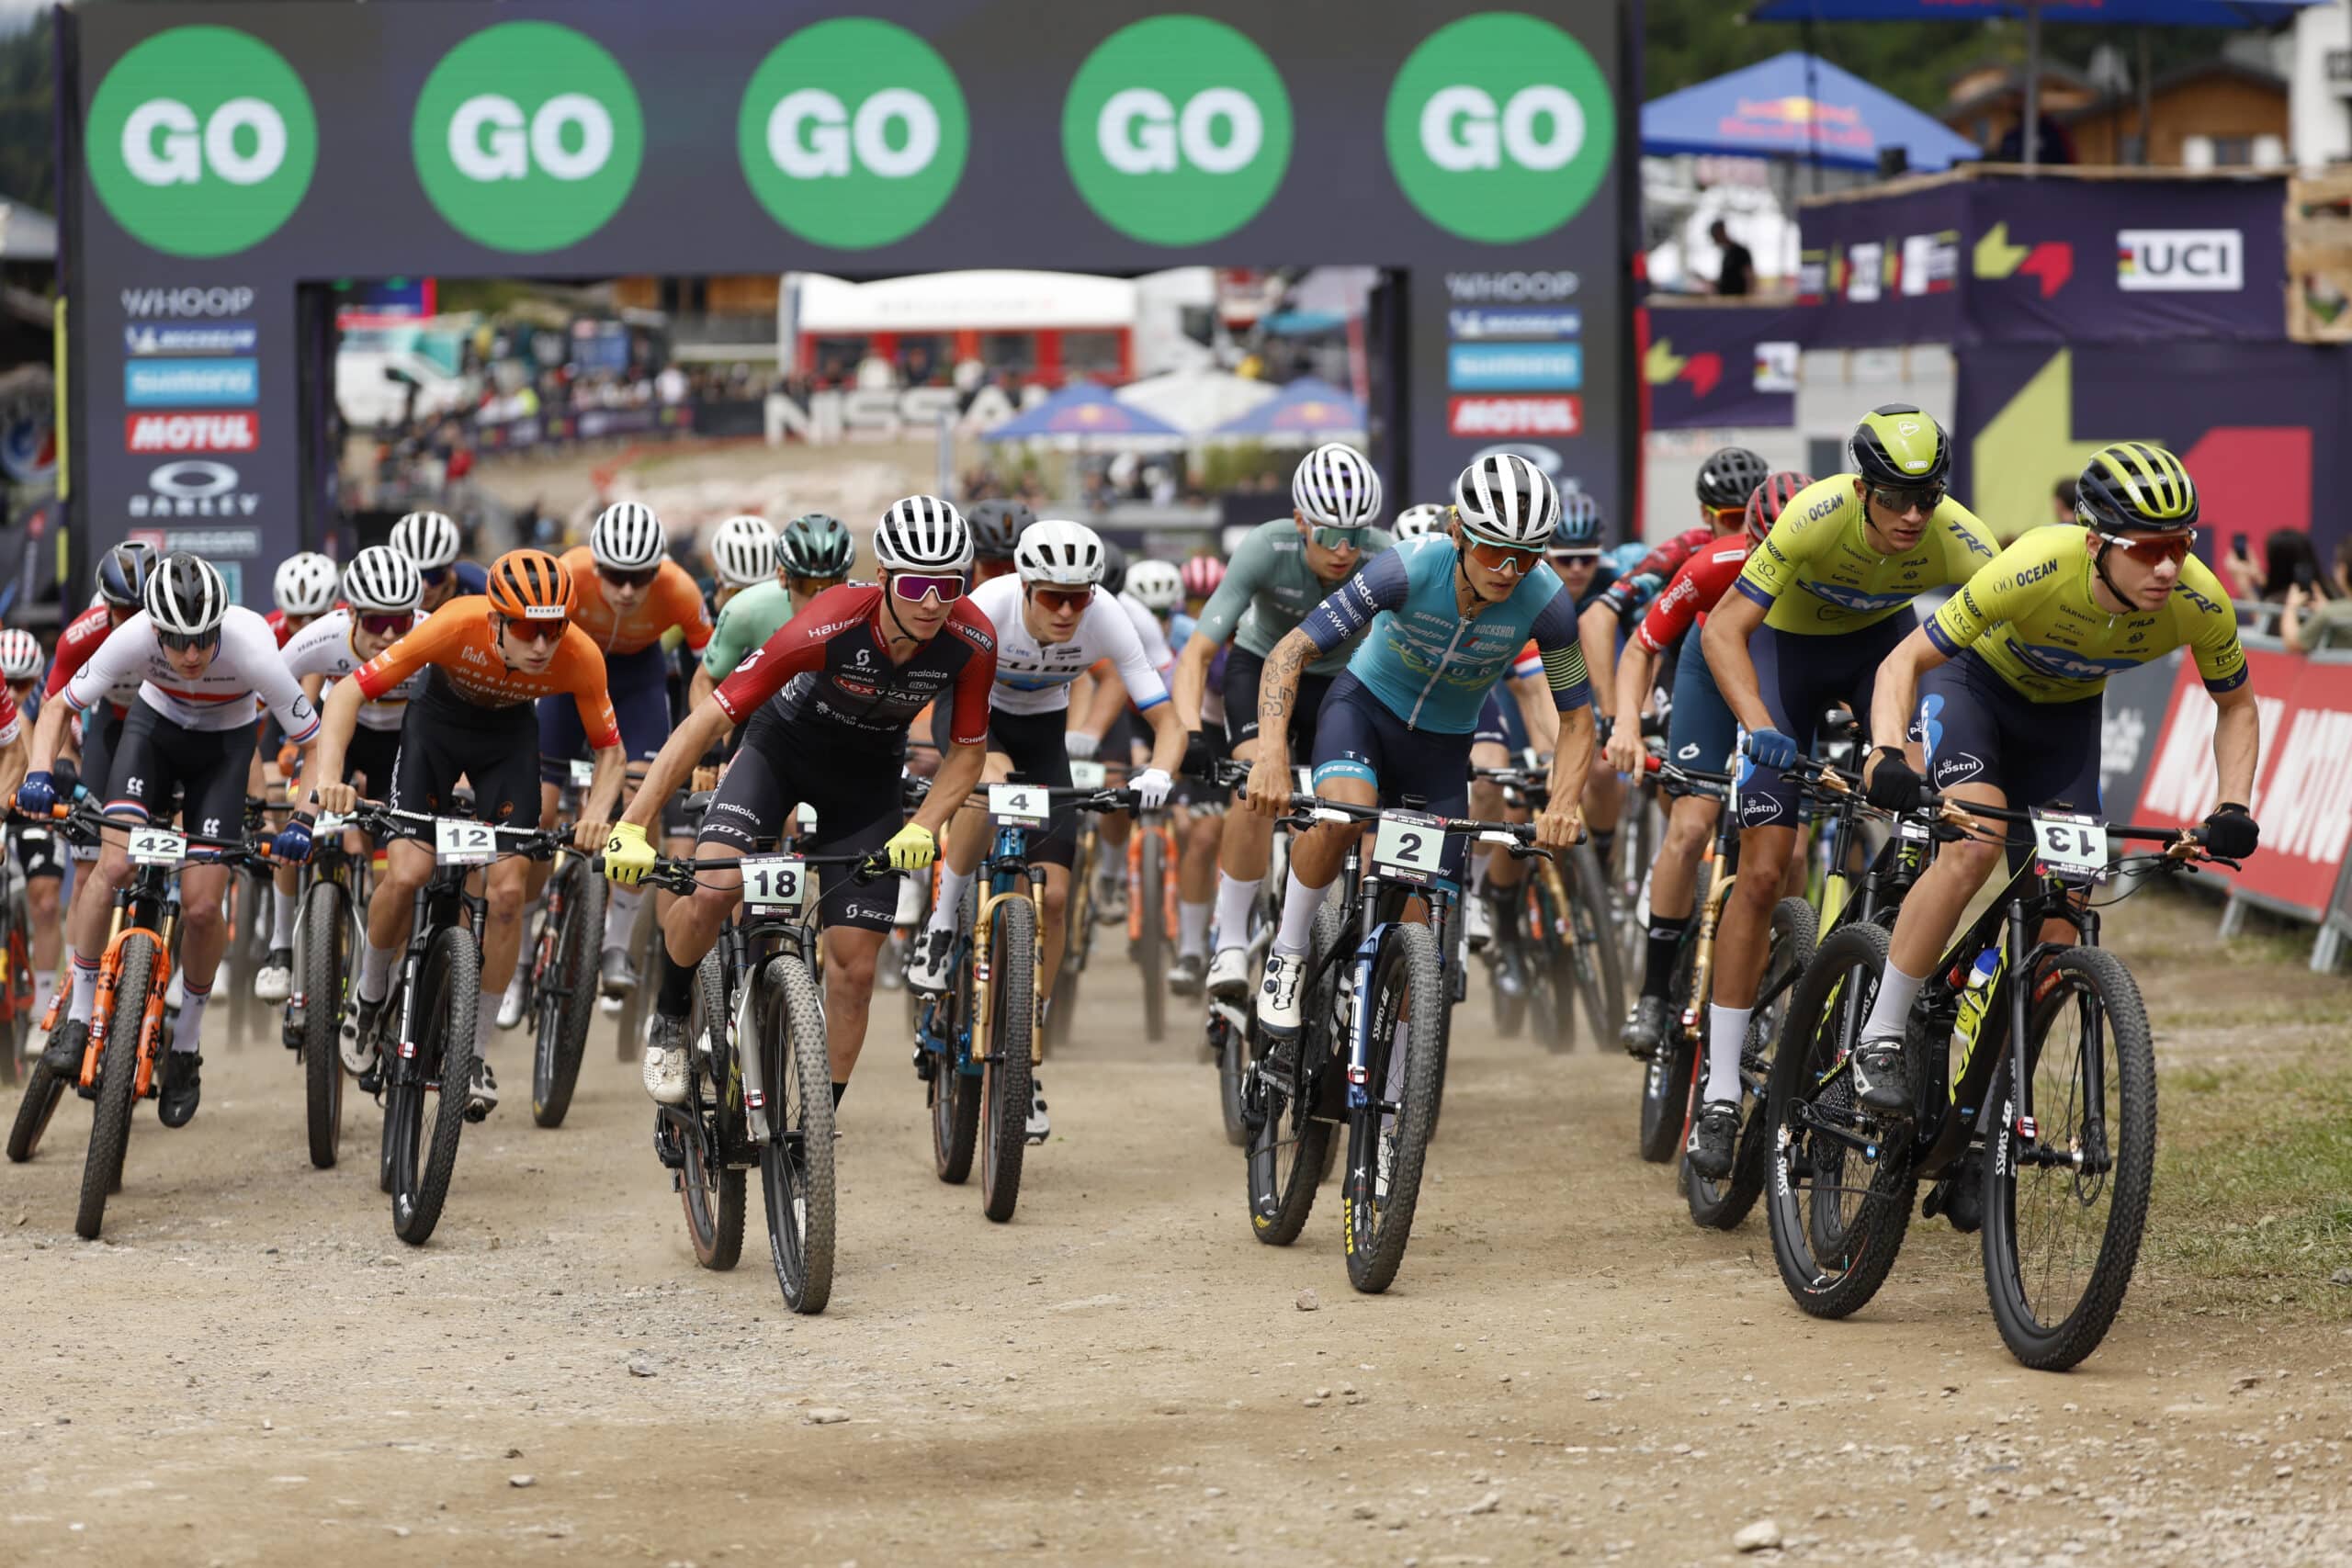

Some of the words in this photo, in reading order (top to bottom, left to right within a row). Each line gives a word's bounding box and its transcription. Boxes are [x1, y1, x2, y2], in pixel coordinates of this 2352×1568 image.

[122, 98, 287, 186] GO
[448, 94, 613, 180] GO
[767, 88, 939, 178] GO
[1097, 87, 1262, 175] GO
[1420, 85, 1586, 171] GO
[2143, 244, 2228, 276] UCI
[121, 287, 254, 318] WHOOP
[1453, 398, 1577, 433] MOTUL
[131, 414, 253, 450] MOTUL
[1808, 492, 1844, 522] OCEAN
[1948, 520, 1994, 558] TRP
[2017, 558, 2058, 588] OCEAN
[2174, 580, 2222, 615] TRP
[1413, 611, 1455, 630] SRAM
[2060, 604, 2096, 624] GARMIN
[841, 664, 880, 673] SCOTT
[1937, 761, 1977, 780] postnl
[1009, 794, 1029, 810] 4
[1744, 802, 1777, 817] postnl
[136, 838, 179, 854] 42
[447, 829, 488, 847] 12
[1396, 832, 1422, 863] 2
[2045, 827, 2096, 857] 13
[753, 870, 797, 897] 18
[860, 908, 894, 921] SCO
[1373, 1005, 1385, 1041] SWISS
[145, 1023, 158, 1058] FOX
[2002, 1100, 2012, 1129] DT
[1996, 1130, 2009, 1176] SWISS
[1777, 1156, 1788, 1196] SWISS
[1344, 1197, 1354, 1256] MAXXIS
